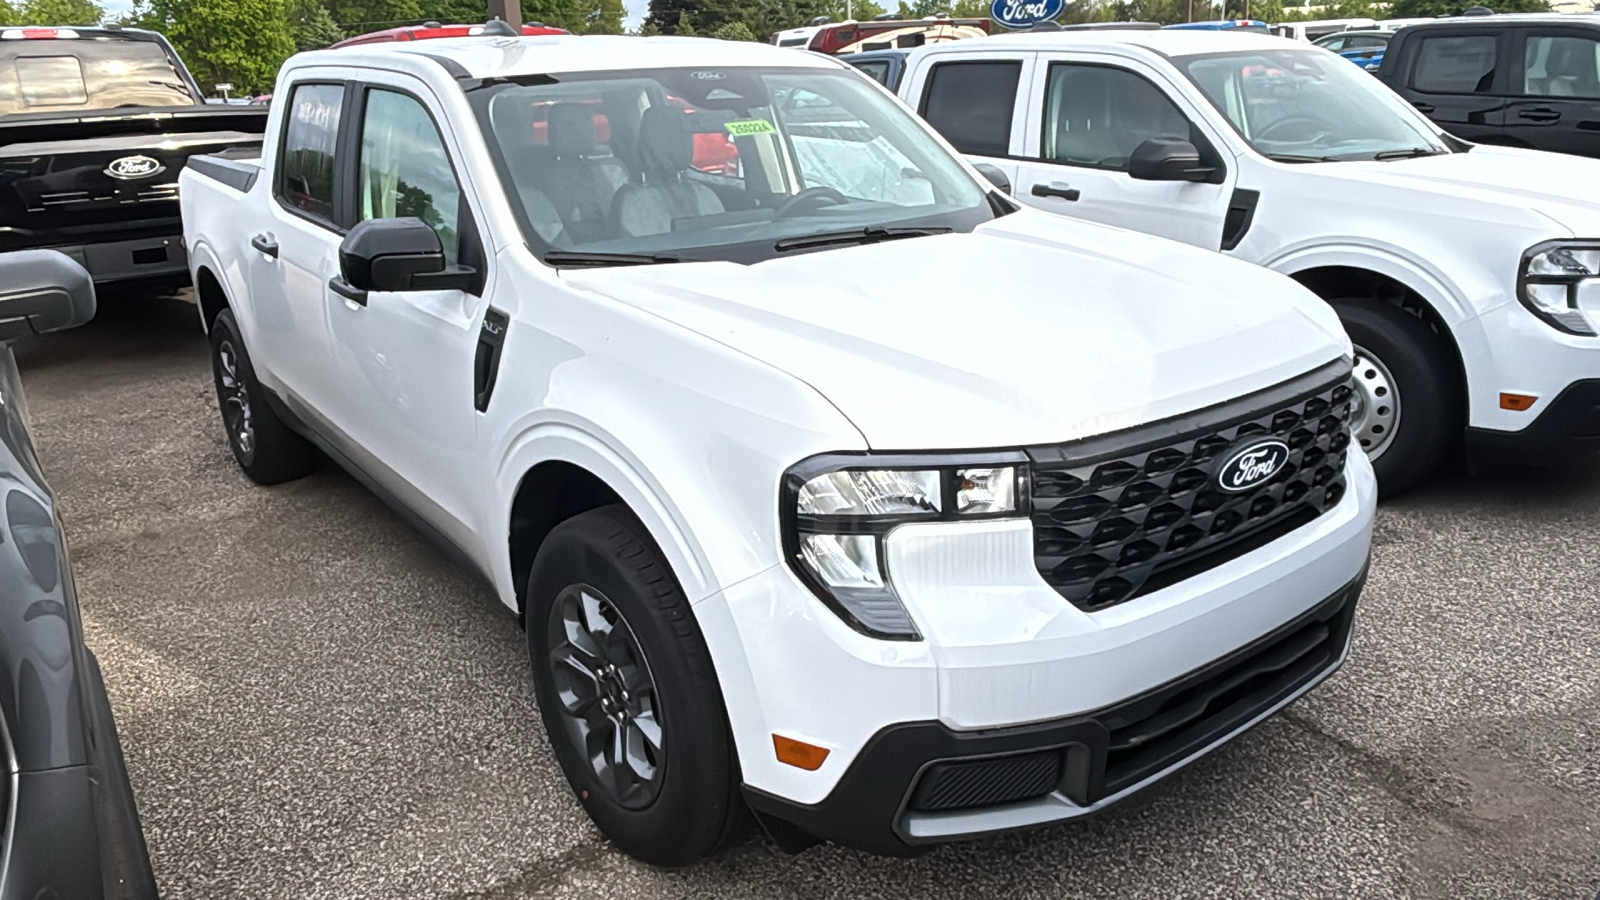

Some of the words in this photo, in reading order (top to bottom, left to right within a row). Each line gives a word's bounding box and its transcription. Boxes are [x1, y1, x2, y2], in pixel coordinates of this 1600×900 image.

[1003, 0, 1048, 21] Ford
[731, 123, 771, 134] 260224
[117, 160, 151, 173] Ford
[1232, 448, 1278, 486] Ford
